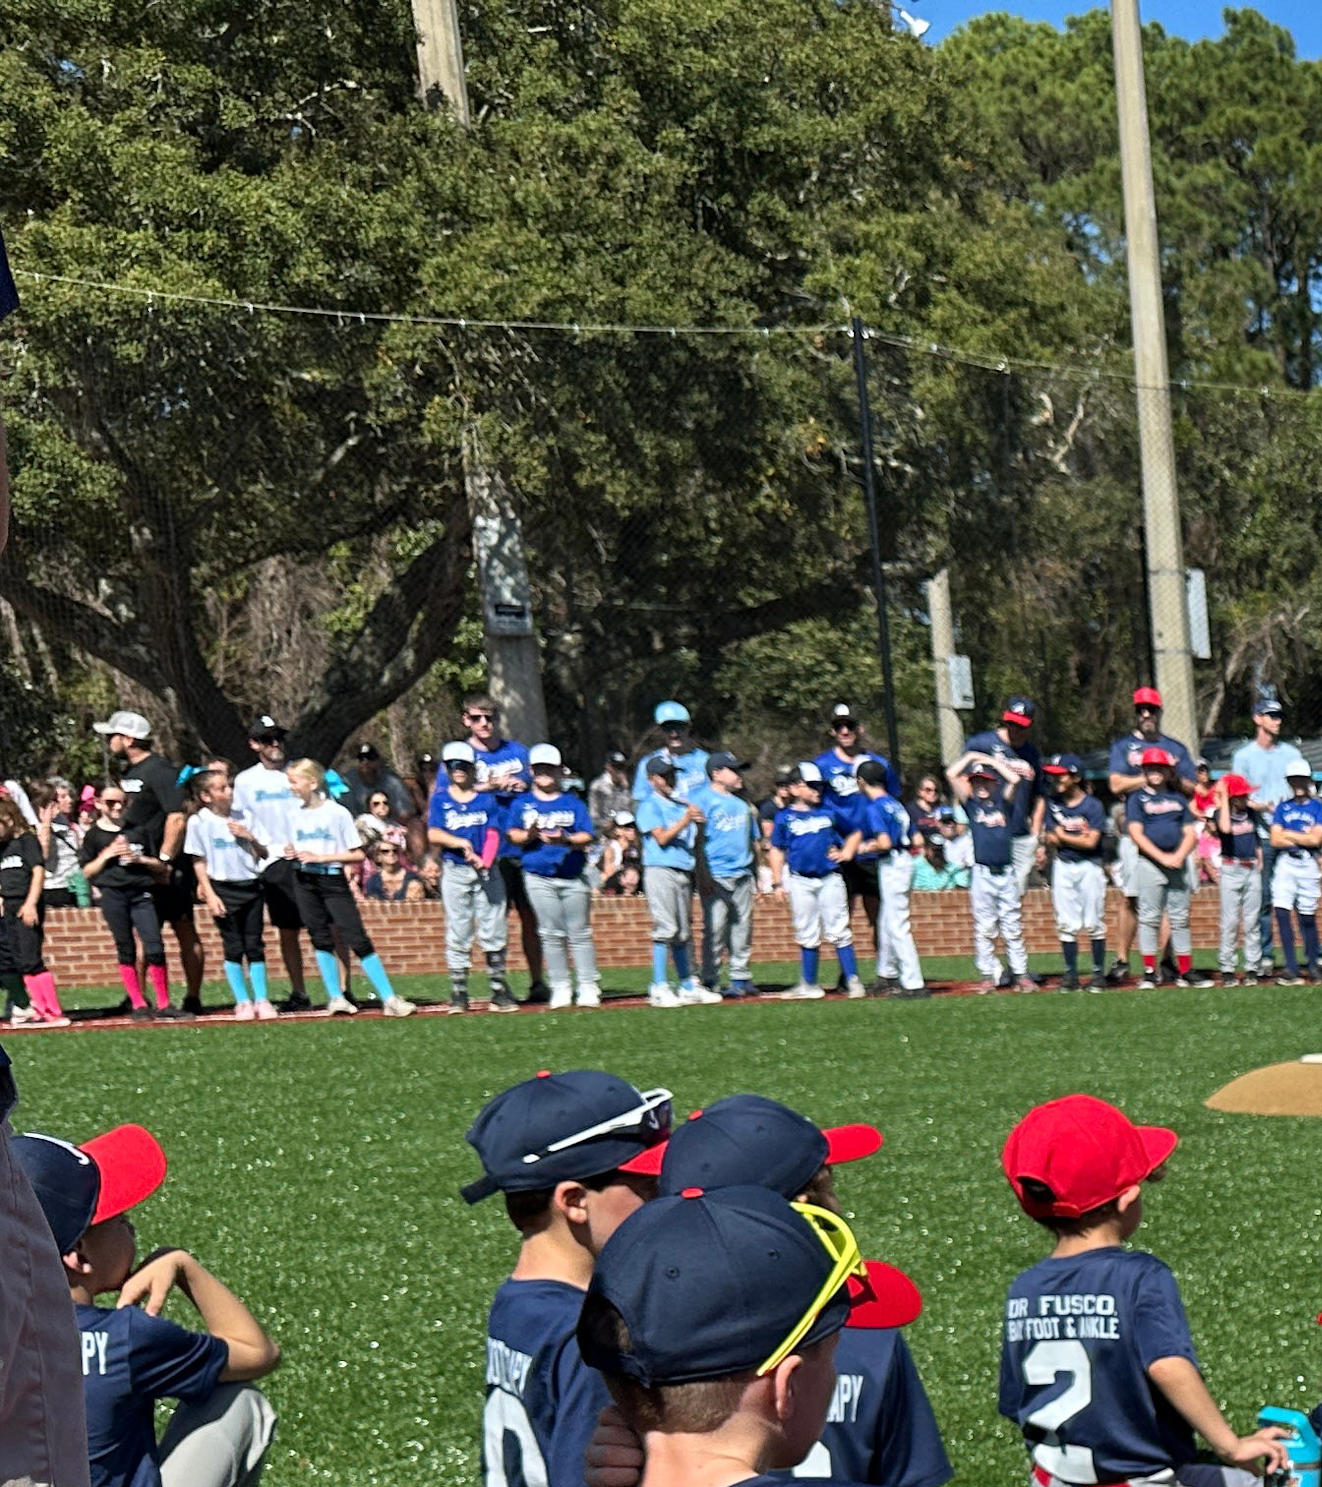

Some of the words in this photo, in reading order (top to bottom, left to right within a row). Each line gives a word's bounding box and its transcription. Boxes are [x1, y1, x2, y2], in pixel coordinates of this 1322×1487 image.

[1008, 1297, 1029, 1319] DR
[1026, 1317, 1060, 1340] FOOT
[1065, 1316, 1077, 1339] &
